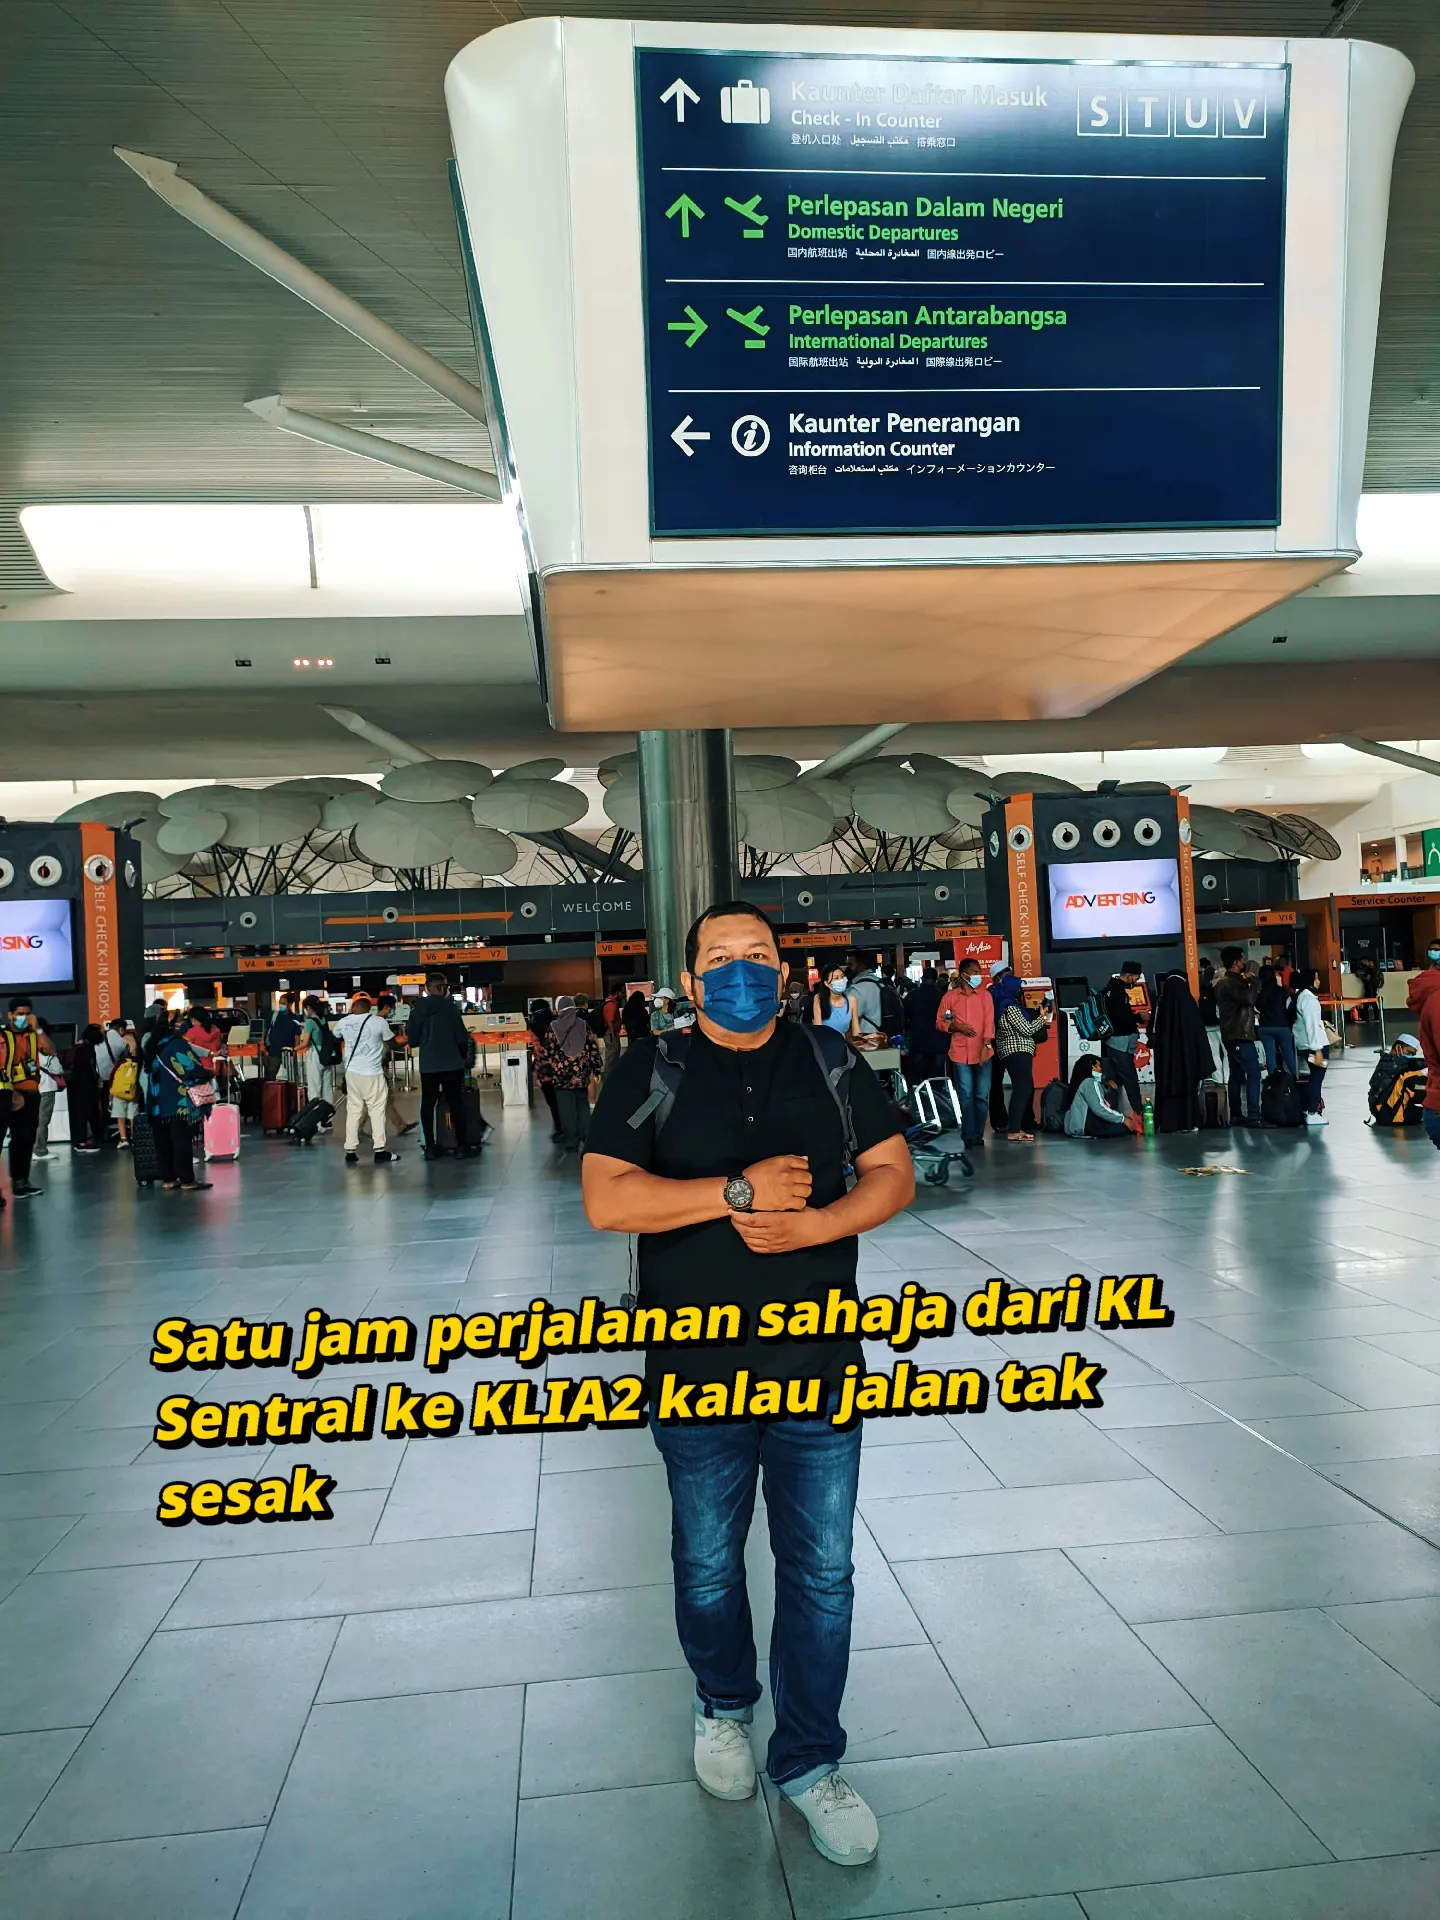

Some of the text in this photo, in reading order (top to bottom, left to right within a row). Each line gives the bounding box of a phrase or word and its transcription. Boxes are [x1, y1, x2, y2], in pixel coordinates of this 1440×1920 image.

[791, 81, 1048, 107] Kaunter Daftar Masuk
[1090, 95, 1109, 127] S
[1137, 97, 1159, 128] T
[1185, 98, 1208, 129] U
[1233, 98, 1257, 129] V
[791, 110, 840, 126] Check
[856, 112, 871, 127] In
[876, 112, 942, 129] Counter
[790, 133, 842, 146] 登机入口处
[787, 193, 1064, 223] Perlepasan Dalam Negeri
[788, 223, 959, 243] Domestic Departures
[787, 247, 848, 259] 国内航班出站
[855, 247, 920, 260] المغادرة المحلية
[927, 249, 1005, 260] 国内線出発ロビー
[788, 304, 1067, 330] Perlepasan Antarabangsa
[789, 333, 988, 352] International Departures
[788, 356, 849, 368] 国际航班出站
[856, 356, 919, 368] المغادرة الدولية
[925, 356, 1003, 368] 国際線出発ロビー
[788, 412, 1021, 437] Kaunter Penerangan
[788, 441, 956, 457] Information Counter
[788, 464, 828, 476] 咨询柜台
[877, 464, 900, 476] مكتب
[905, 462, 1056, 475] インフォーメーションカウンター
[562, 901, 632, 913] WELCOME
[1350, 895, 1426, 906] Service Counter
[1016, 852, 1033, 977] SELF CHECK-IN KIOSK
[94, 885, 110, 1018] SELF CHECK-IN KIOSK
[425, 953, 437, 961] V6
[490, 950, 501, 958] V7
[244, 960, 256, 968] V4
[311, 958, 322, 966] V5
